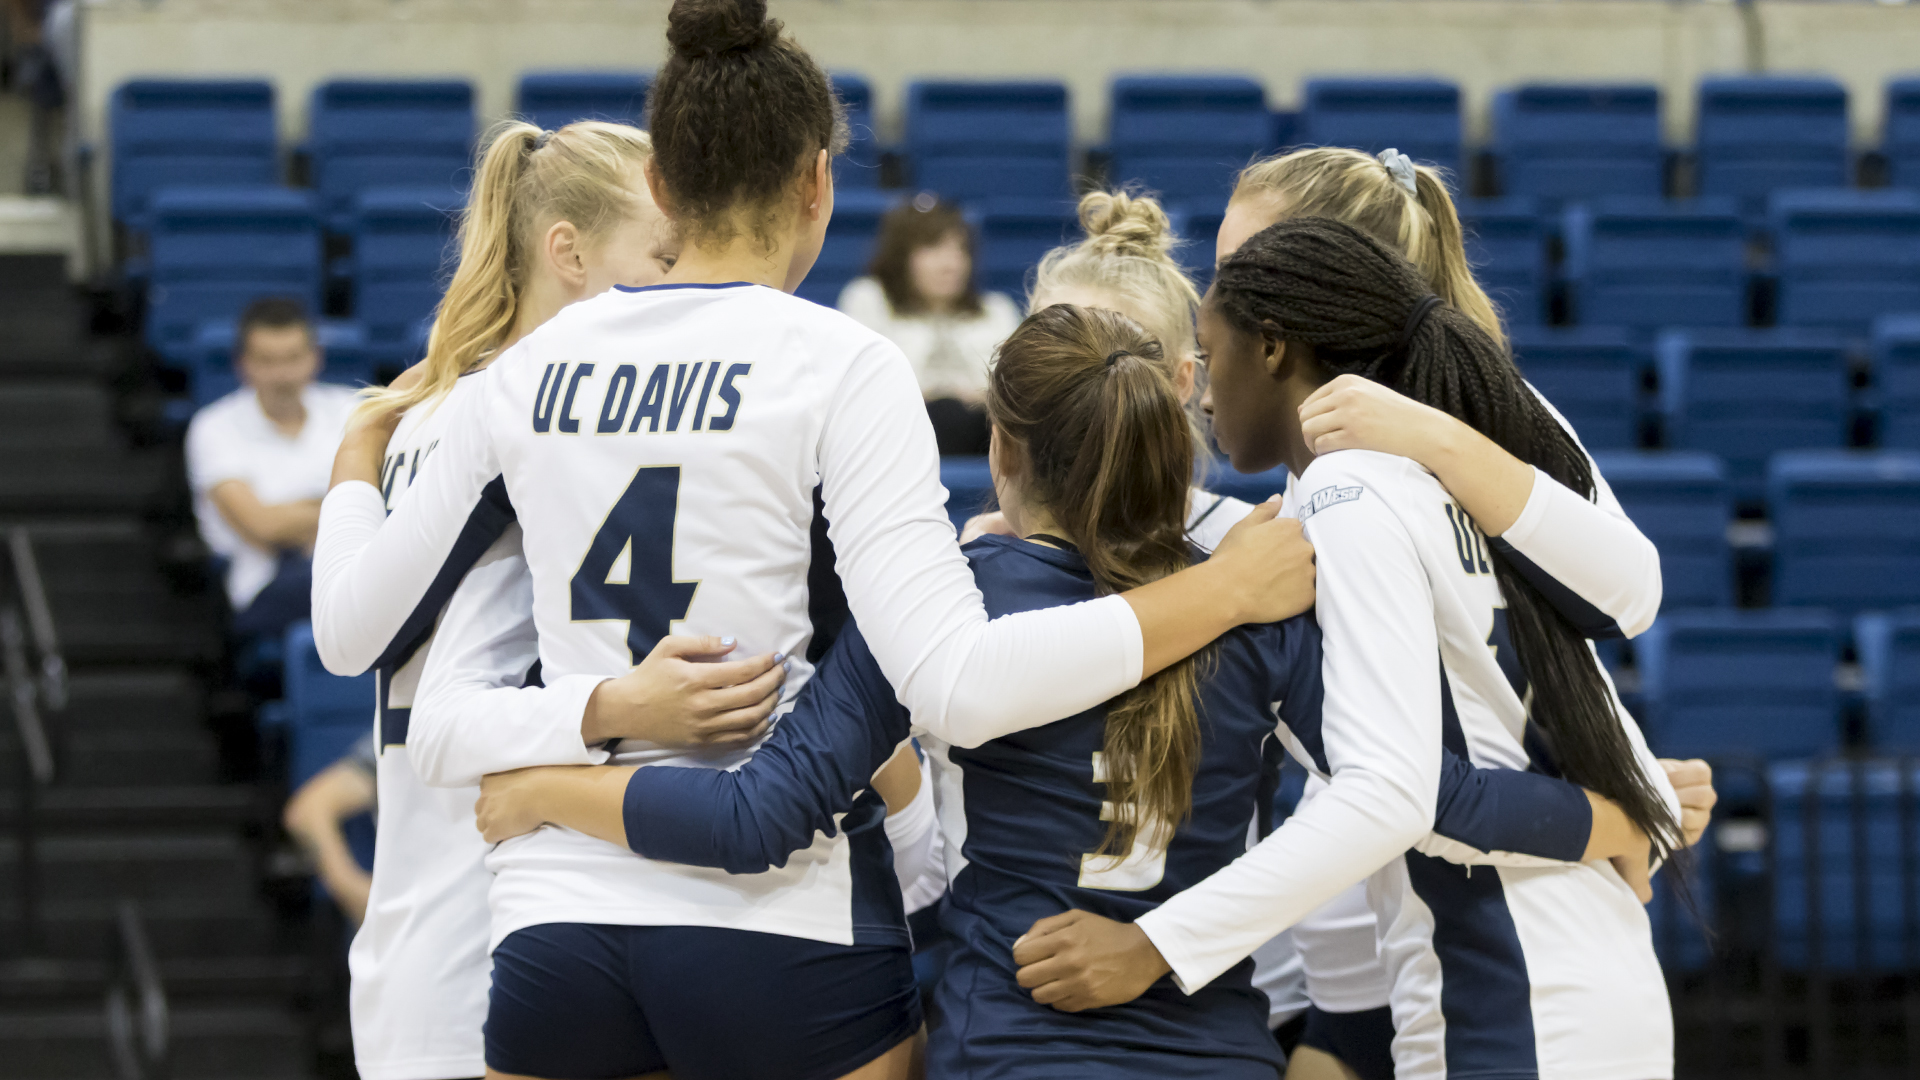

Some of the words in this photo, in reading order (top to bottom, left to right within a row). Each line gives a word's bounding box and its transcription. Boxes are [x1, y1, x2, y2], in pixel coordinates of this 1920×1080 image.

[532, 361, 597, 435] UC
[595, 360, 754, 436] DAVIS
[569, 464, 702, 668] 4
